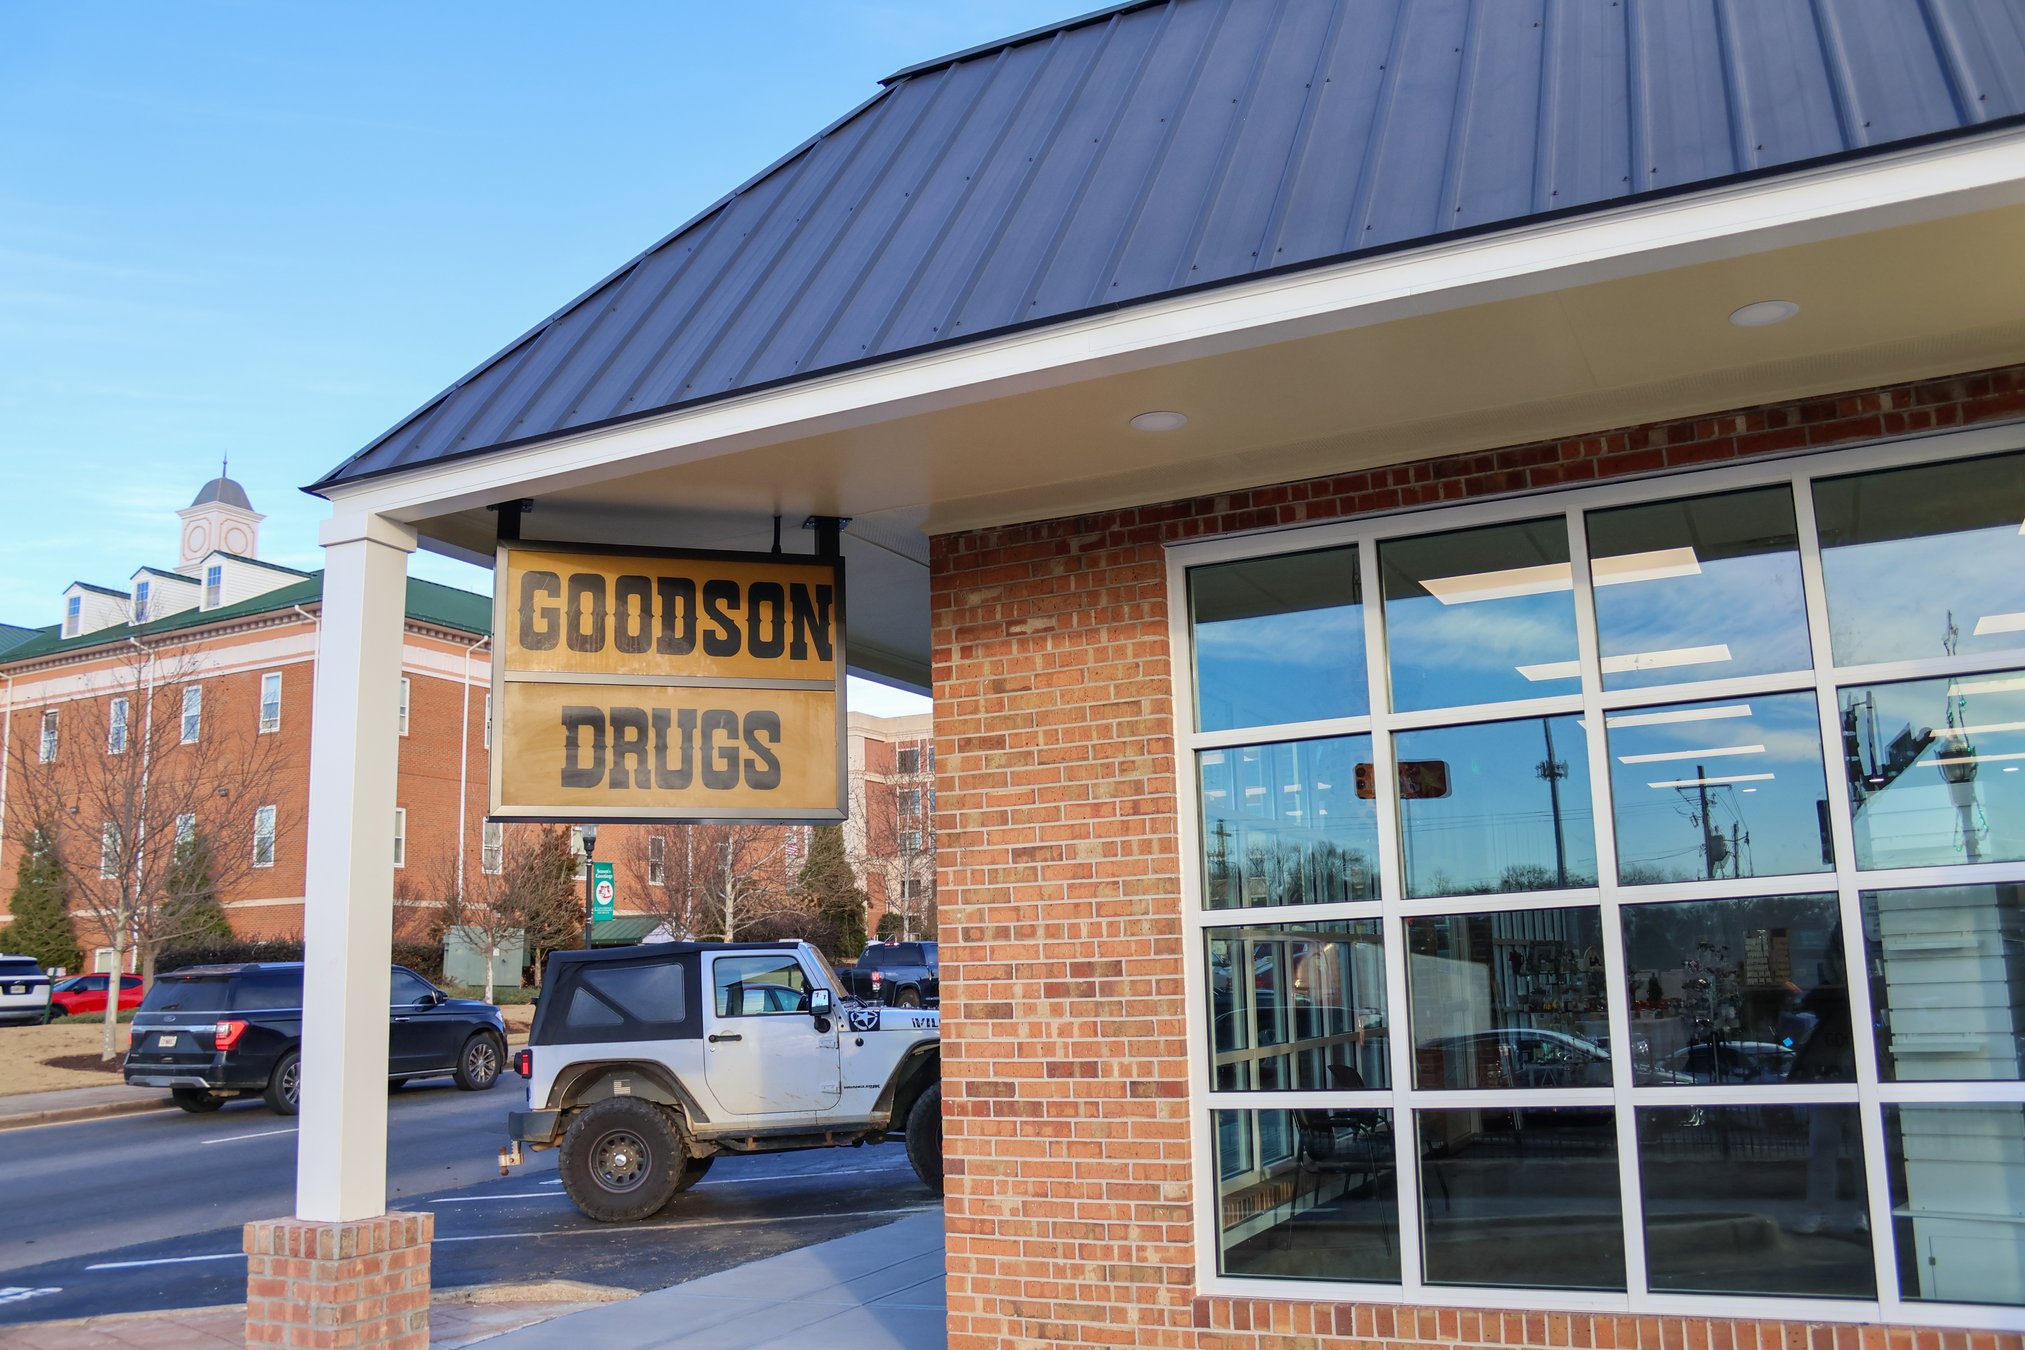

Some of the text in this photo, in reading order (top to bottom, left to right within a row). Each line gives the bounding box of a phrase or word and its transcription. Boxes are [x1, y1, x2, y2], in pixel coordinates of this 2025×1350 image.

[518, 570, 833, 661] GOODSON
[560, 705, 781, 790] DRUGS
[911, 1017, 940, 1028] WIL
